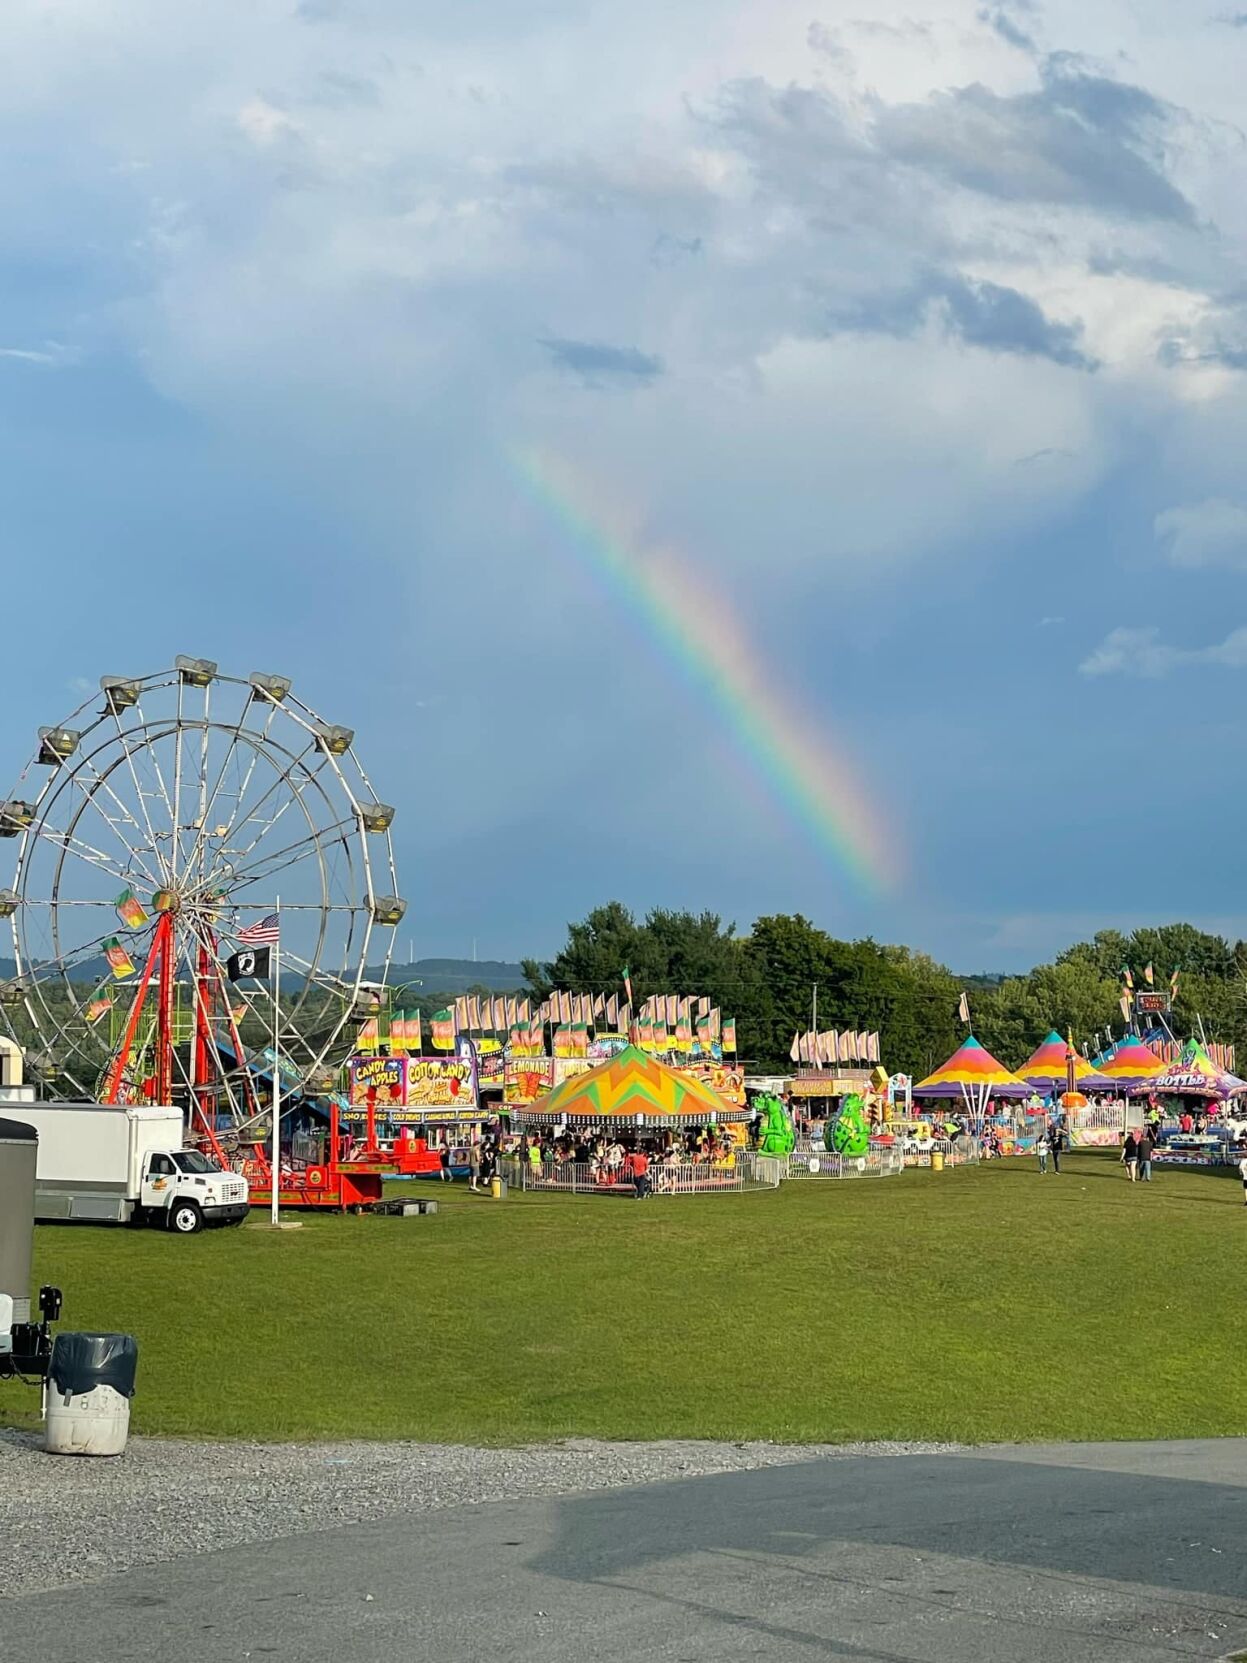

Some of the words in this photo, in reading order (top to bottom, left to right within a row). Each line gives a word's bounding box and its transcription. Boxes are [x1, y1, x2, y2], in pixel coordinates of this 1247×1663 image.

[356, 1060, 386, 1080] CANDY
[409, 1062, 441, 1083] COTTON
[441, 1063, 471, 1082] CANDY
[508, 1060, 550, 1076] LEMONADE
[370, 1071, 399, 1086] APPLES
[1156, 1075, 1206, 1086] BOTTLE
[343, 1113, 360, 1121] SNO
[1152, 1155, 1210, 1165] OTTLE
